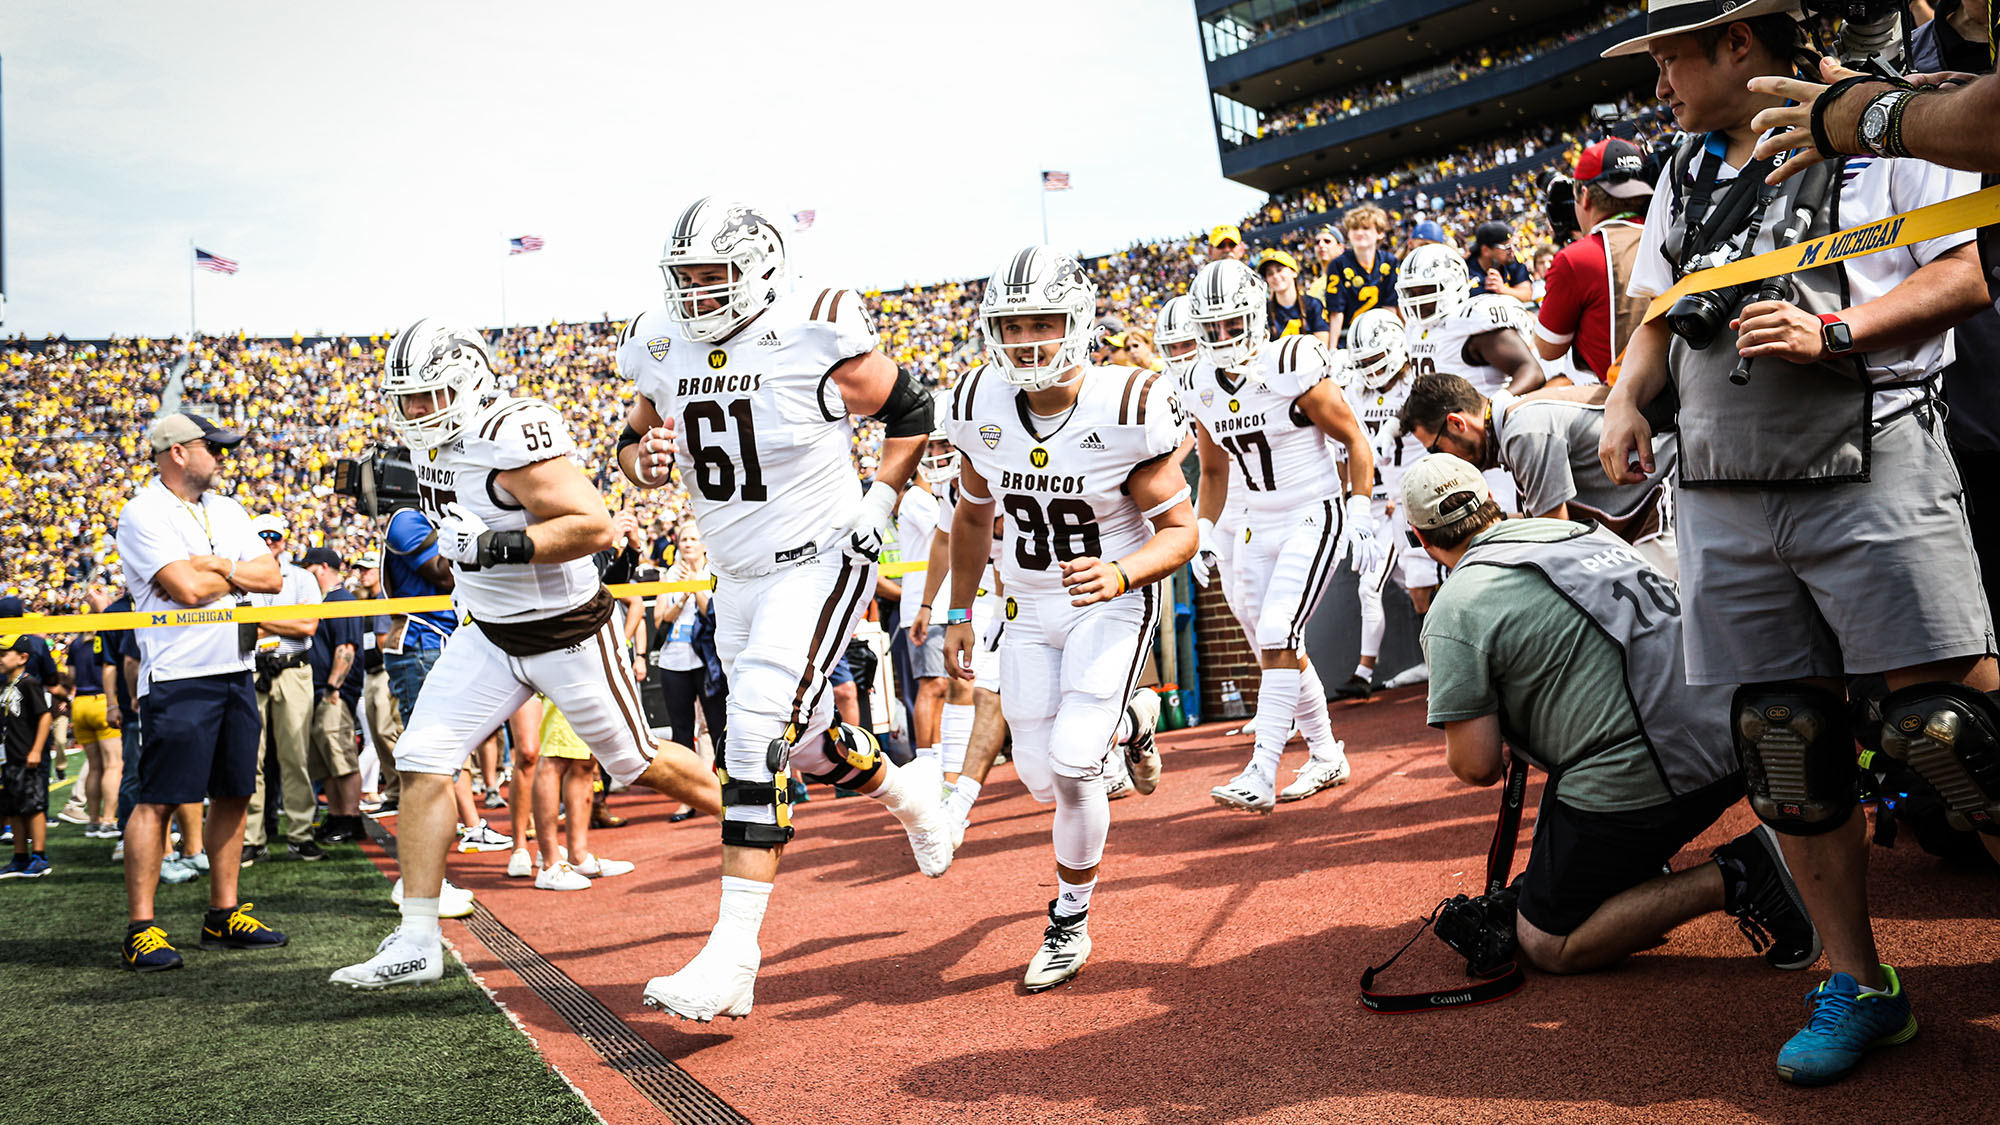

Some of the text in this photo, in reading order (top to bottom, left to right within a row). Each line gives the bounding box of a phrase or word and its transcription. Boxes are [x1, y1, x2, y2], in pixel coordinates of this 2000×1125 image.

[1797, 217, 1906, 267] M MICHIGAN
[1327, 274, 1340, 294] 2
[1489, 305, 1508, 324] 90
[677, 374, 762, 396] BRONCOS
[1214, 412, 1266, 433] BRONCOS
[521, 421, 552, 451] 55
[1080, 442, 1105, 450] adidas
[683, 399, 767, 501] 61
[1221, 430, 1276, 491] 17
[1000, 471, 1086, 494] BRONCOS
[1434, 478, 1459, 495] WMU
[152, 610, 233, 625] M MICHIGAN
[1430, 993, 1472, 1004] Canon
